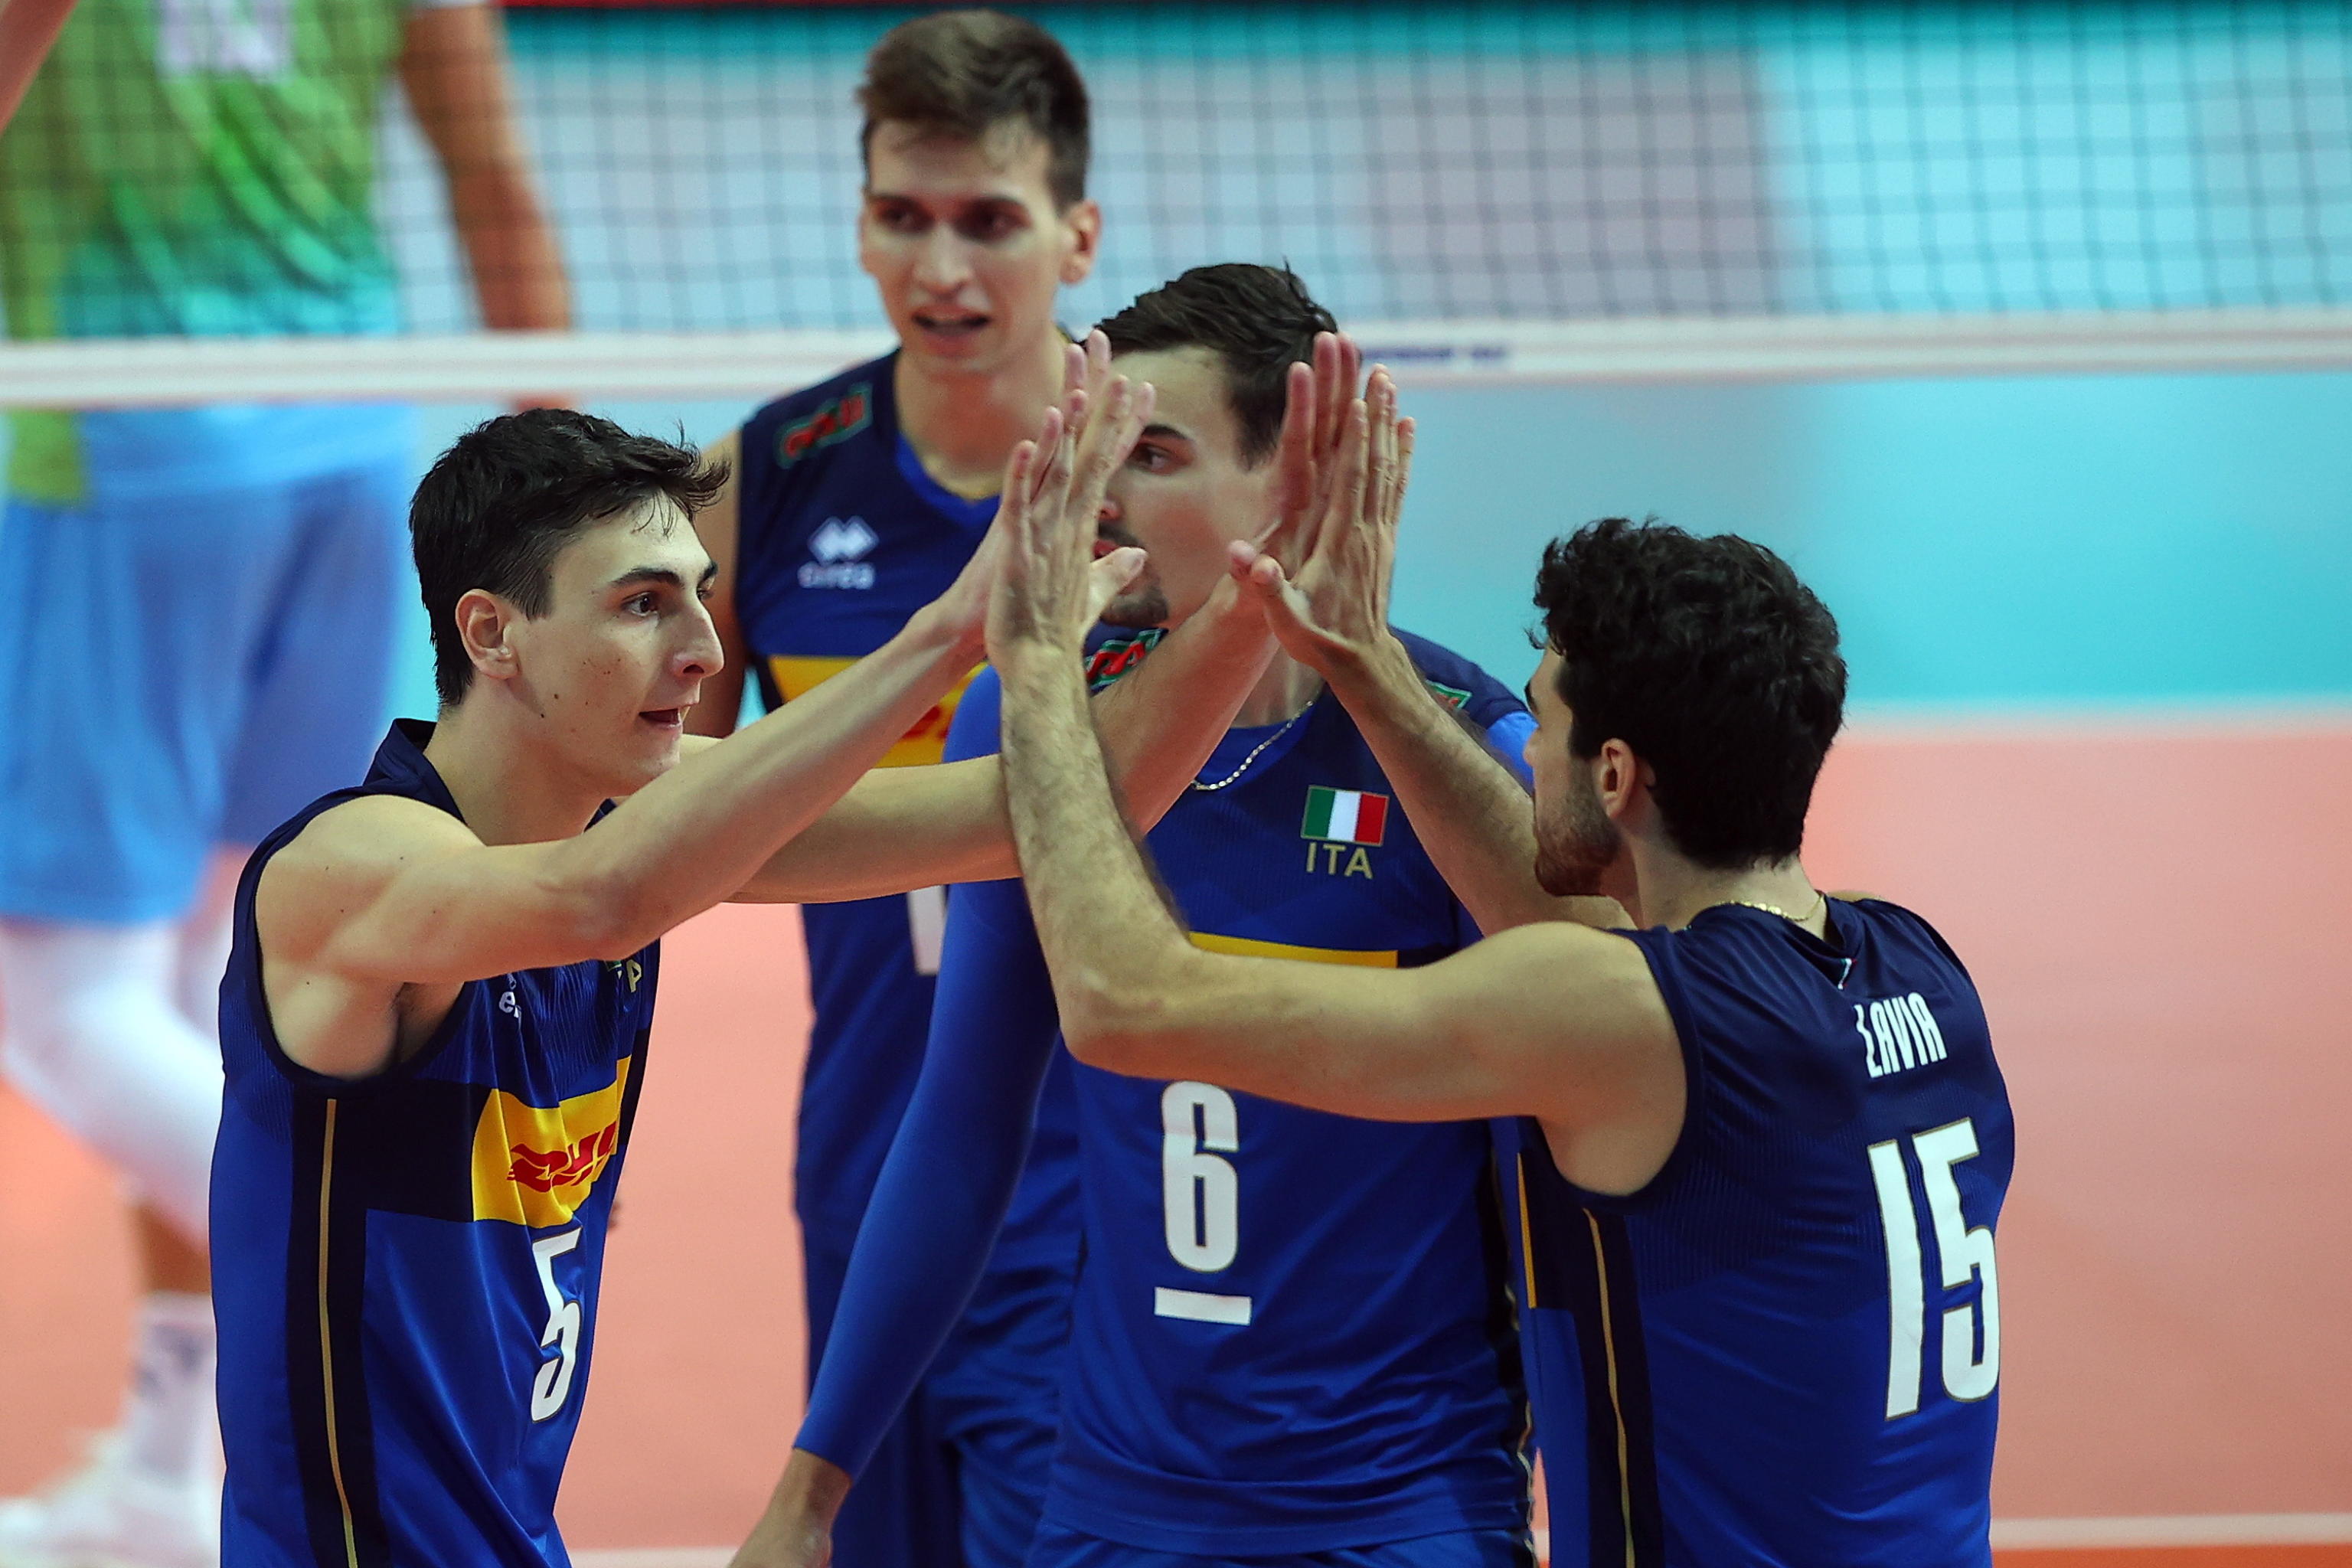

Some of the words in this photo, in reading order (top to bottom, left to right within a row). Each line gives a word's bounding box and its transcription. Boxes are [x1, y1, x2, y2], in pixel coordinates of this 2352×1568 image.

[1305, 841, 1373, 879] ITA
[1853, 991, 1948, 1078] LAVIA
[1161, 1080, 1239, 1272] 6
[1867, 1117, 2001, 1420] 15
[531, 1227, 582, 1423] 5
